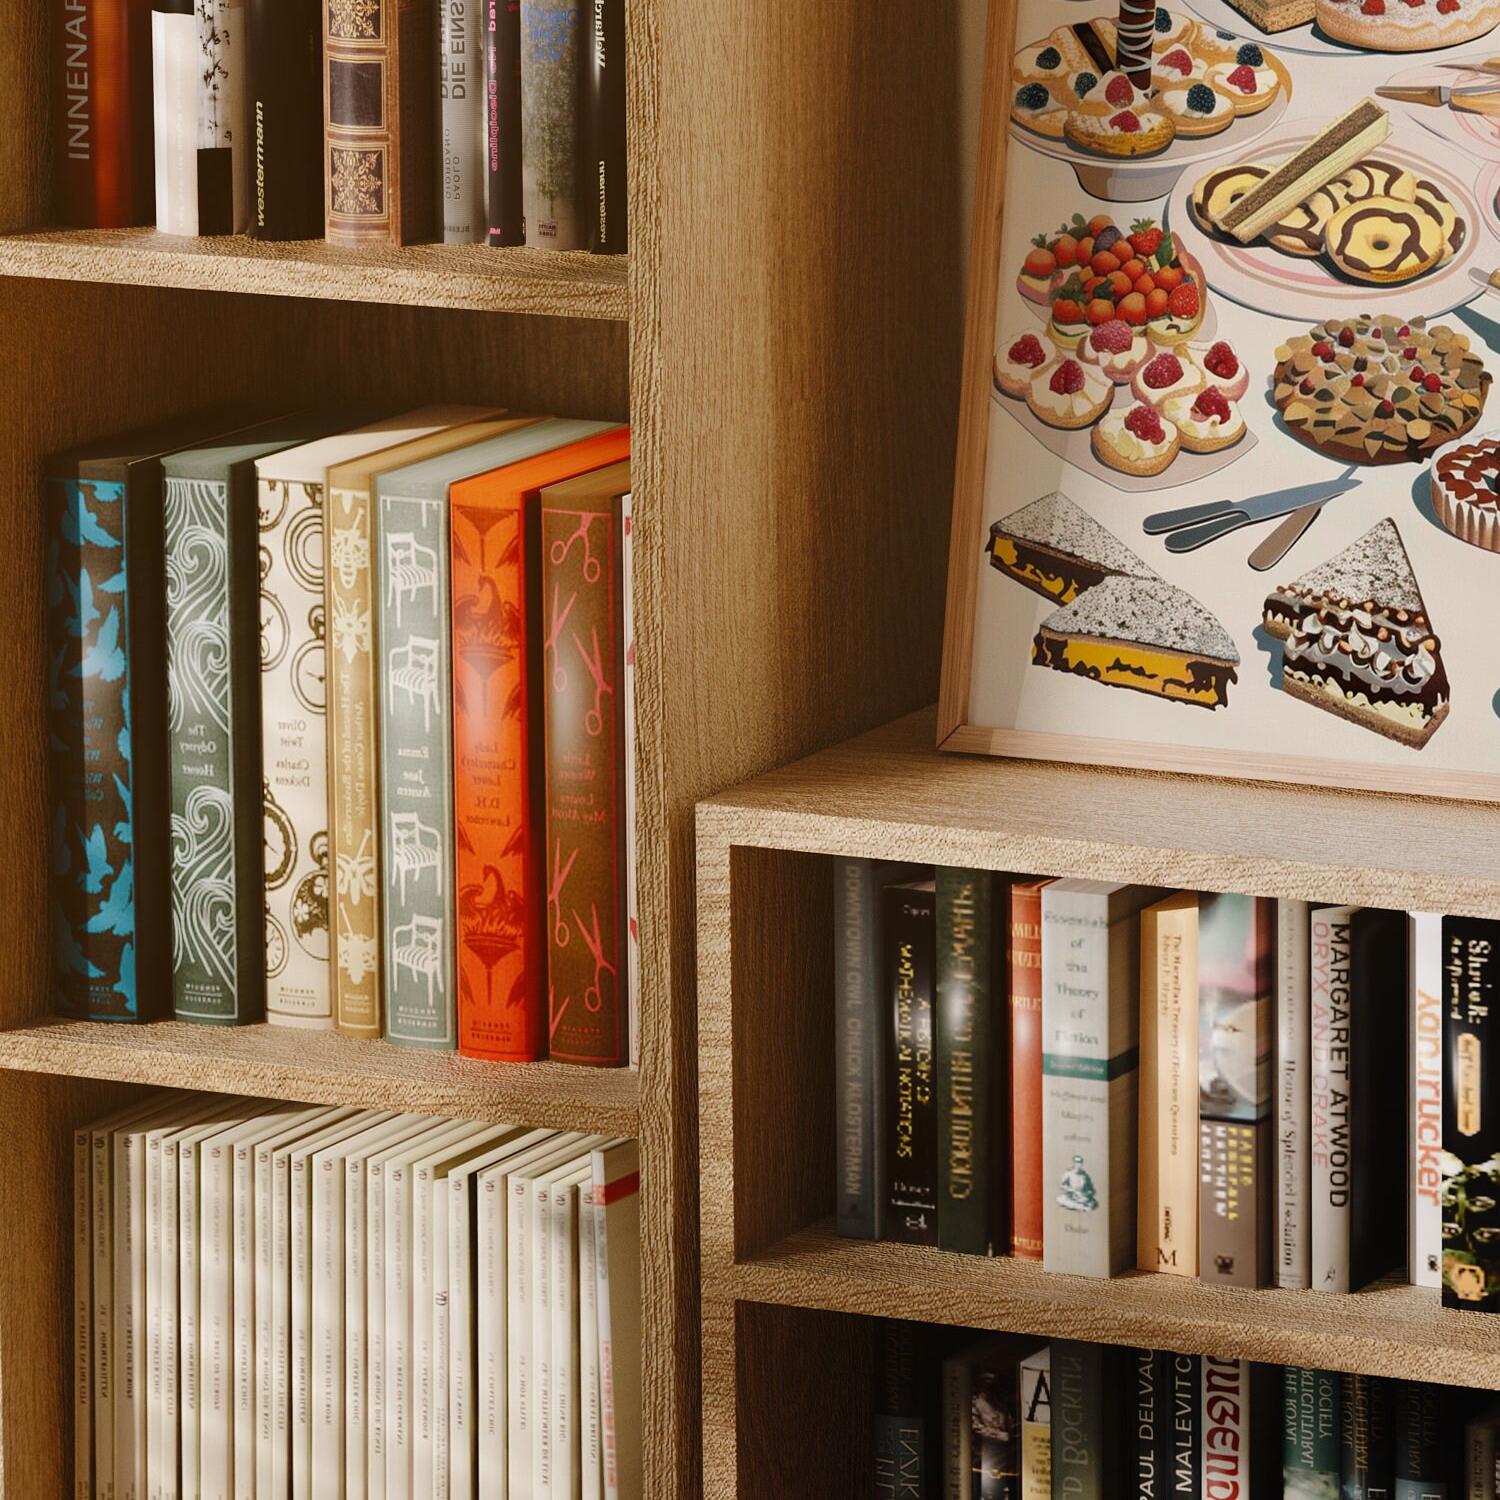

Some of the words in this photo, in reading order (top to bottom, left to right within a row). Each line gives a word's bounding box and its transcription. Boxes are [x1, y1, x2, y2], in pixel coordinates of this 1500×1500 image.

[254, 100, 266, 228] westermann
[1065, 961, 1089, 974] the
[1070, 937, 1086, 951] of
[1312, 921, 1330, 992] ORYX
[845, 971, 865, 1010] OWL
[1056, 983, 1100, 1002] Theory
[1329, 922, 1350, 1081] MARGARET
[1054, 1029, 1099, 1049] Fiction
[1312, 1000, 1330, 1062] AND
[896, 1067, 915, 1159] NOTATIONS
[1281, 1060, 1298, 1103] House
[845, 1080, 865, 1194] KLOSTERMAN
[1312, 1073, 1330, 1169] CRAKE
[1329, 1088, 1350, 1208] ATWOOD
